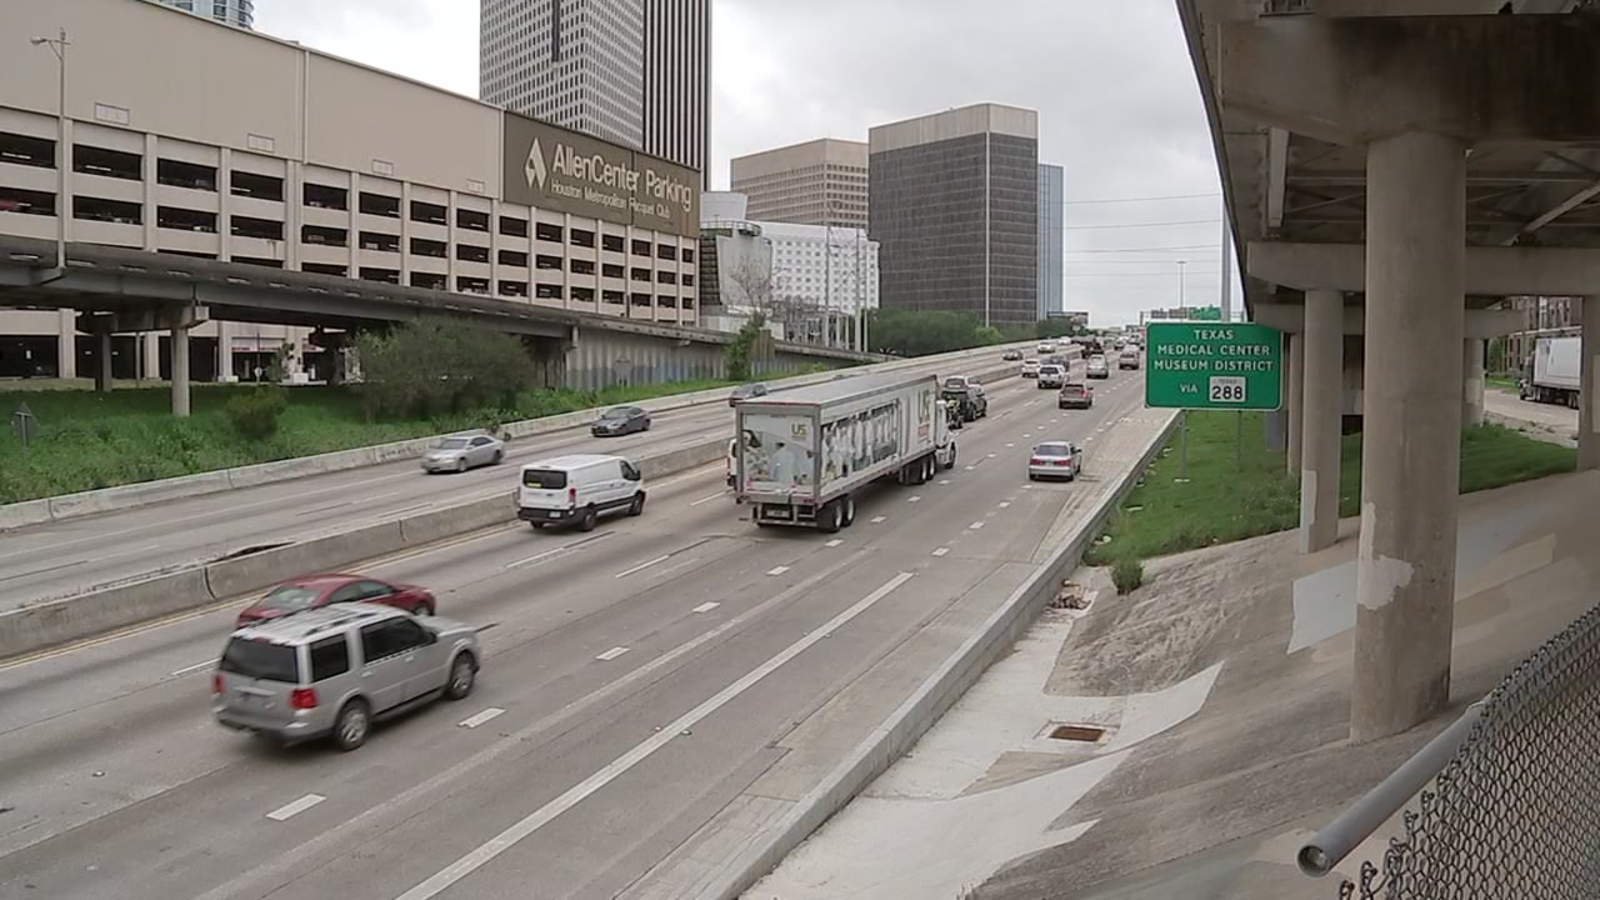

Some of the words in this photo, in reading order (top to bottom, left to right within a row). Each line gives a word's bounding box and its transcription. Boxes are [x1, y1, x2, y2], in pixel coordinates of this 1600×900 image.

[551, 180, 582, 198] Houston
[584, 186, 628, 209] Metropolitan
[645, 169, 692, 212] Parking
[1193, 329, 1234, 340] TEXAS
[1157, 344, 1213, 355] MEDICAL
[1220, 345, 1270, 356] CENTER
[1154, 360, 1208, 370] MUSEUM
[1215, 361, 1273, 371] DISTRICT
[1179, 383, 1198, 393] VIA
[1211, 385, 1243, 400] 288
[791, 424, 806, 435] US
